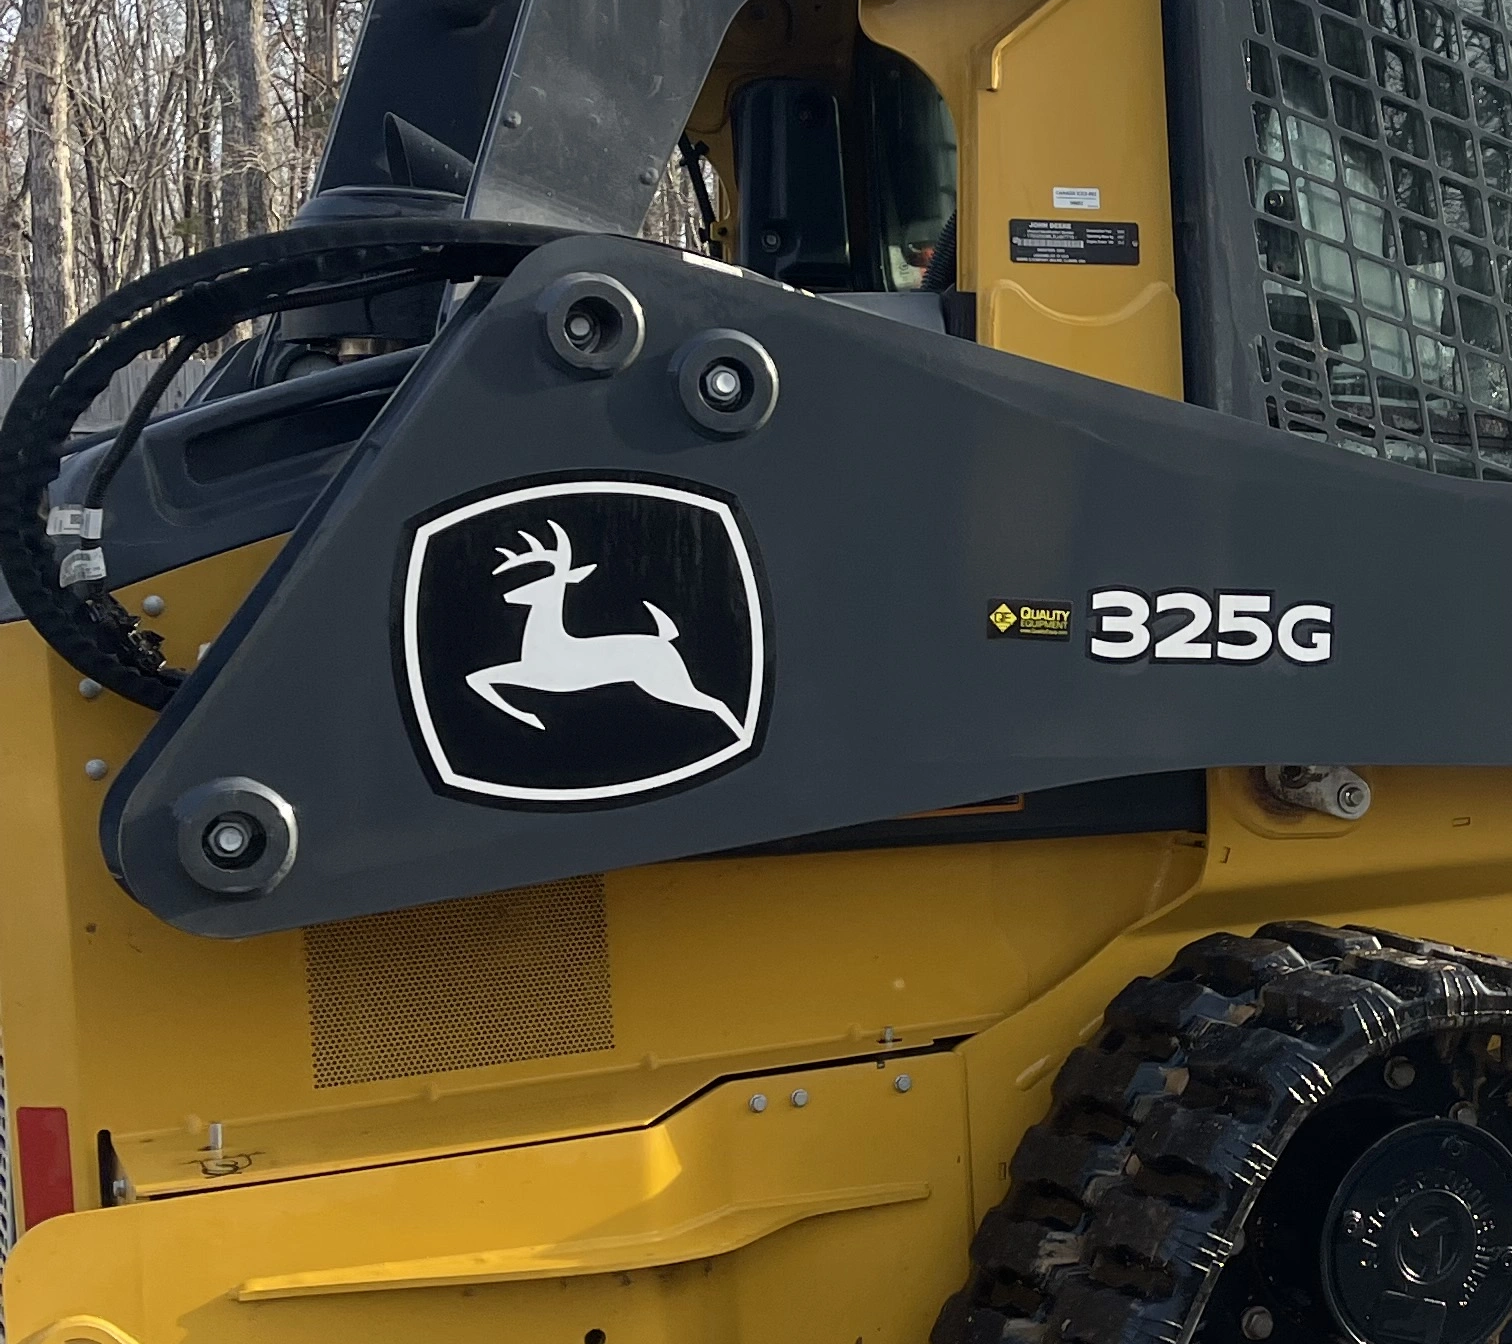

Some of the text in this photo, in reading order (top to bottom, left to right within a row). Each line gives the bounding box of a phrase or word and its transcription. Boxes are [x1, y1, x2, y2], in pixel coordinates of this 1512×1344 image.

[1020, 606, 1071, 622] QUALITY
[1020, 619, 1068, 630] EQUIPMENT
[1090, 589, 1332, 663] 325G
